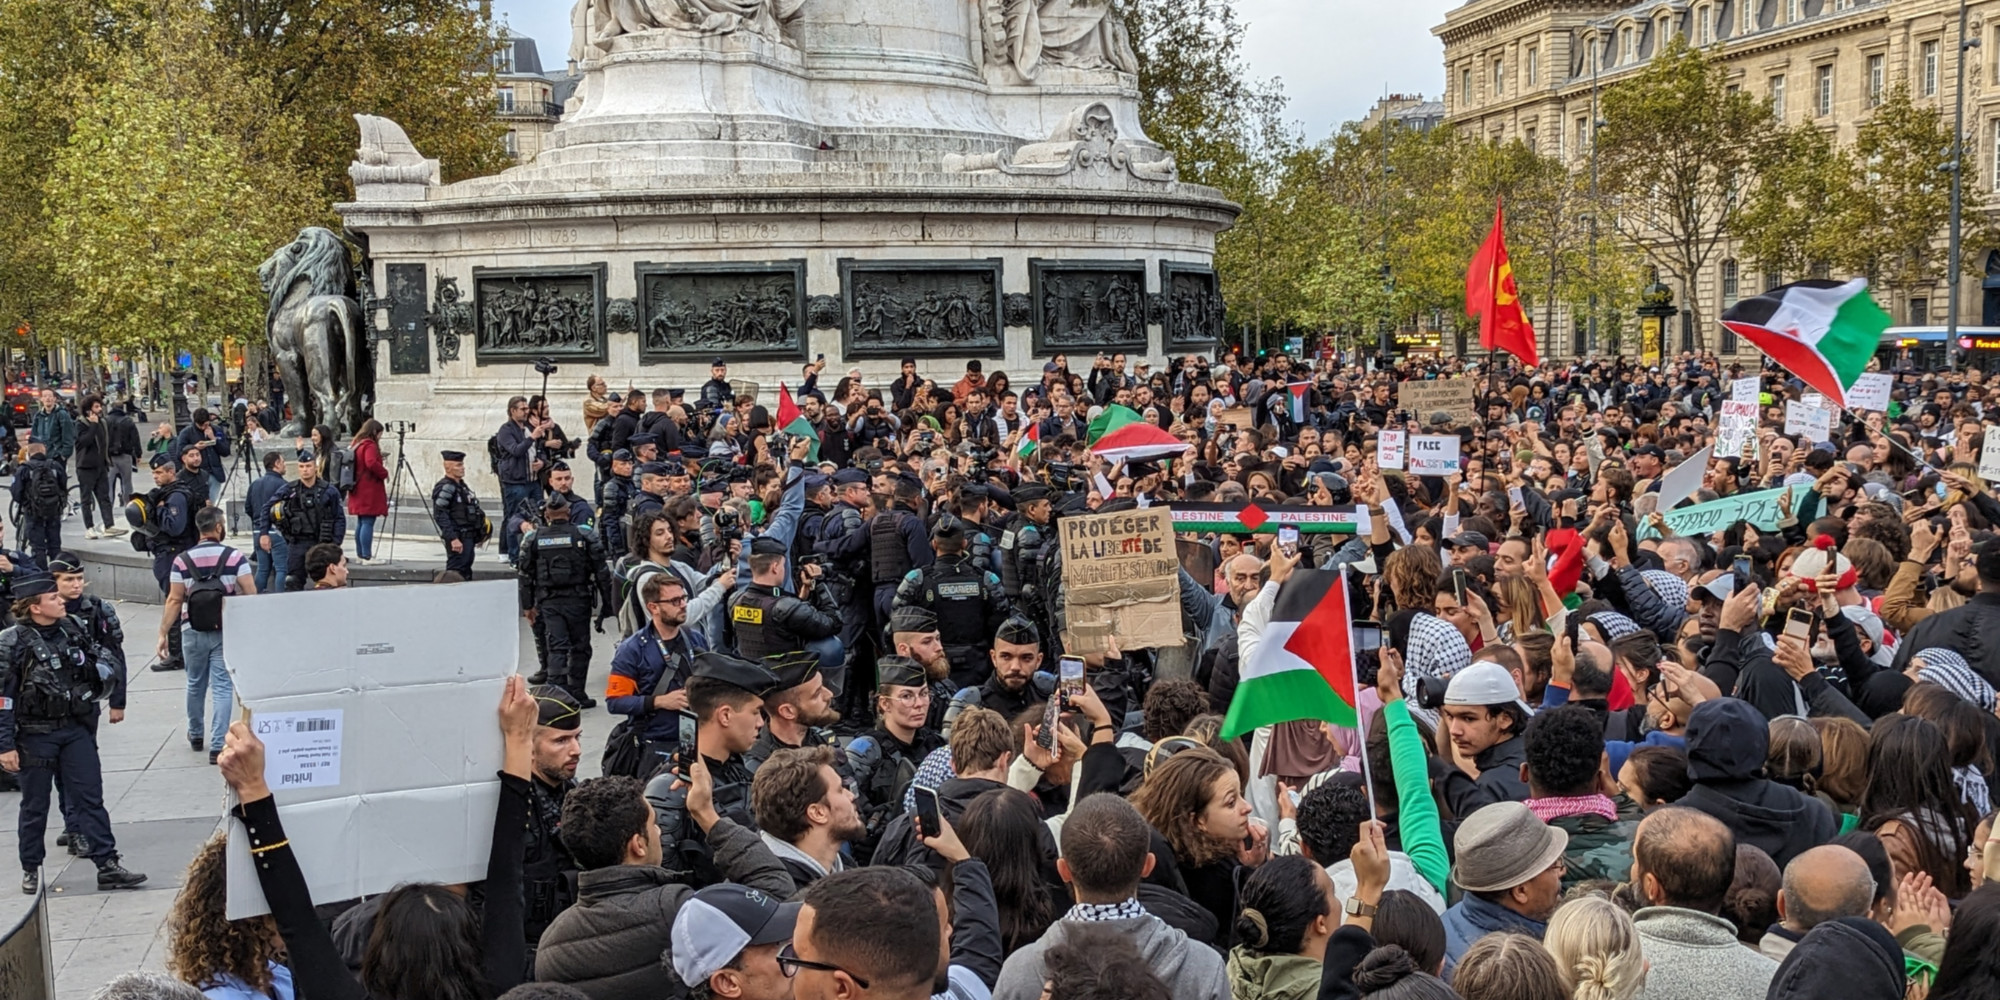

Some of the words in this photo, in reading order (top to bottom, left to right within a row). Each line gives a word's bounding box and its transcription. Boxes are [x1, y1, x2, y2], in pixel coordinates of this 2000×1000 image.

[550, 228, 578, 244] 1789
[657, 225, 670, 240] 14
[676, 223, 740, 240] JUILLET
[746, 223, 780, 239] 1789
[870, 224, 879, 236] 4
[944, 224, 974, 238] 1789
[1050, 223, 1059, 239] 14
[1064, 222, 1109, 240] JUILLET
[1112, 225, 1134, 241] 1790
[1417, 441, 1441, 451] FREE
[1411, 457, 1458, 469] PALESTINE
[1171, 512, 1225, 522] ALESTINE
[1280, 512, 1348, 522] PALESTINE
[1068, 515, 1160, 540] PROTÉGER
[1070, 542, 1090, 560] LA
[1093, 534, 1142, 558] LIBERTÉ
[1143, 537, 1163, 554] DE
[282, 772, 312, 784] Initial
